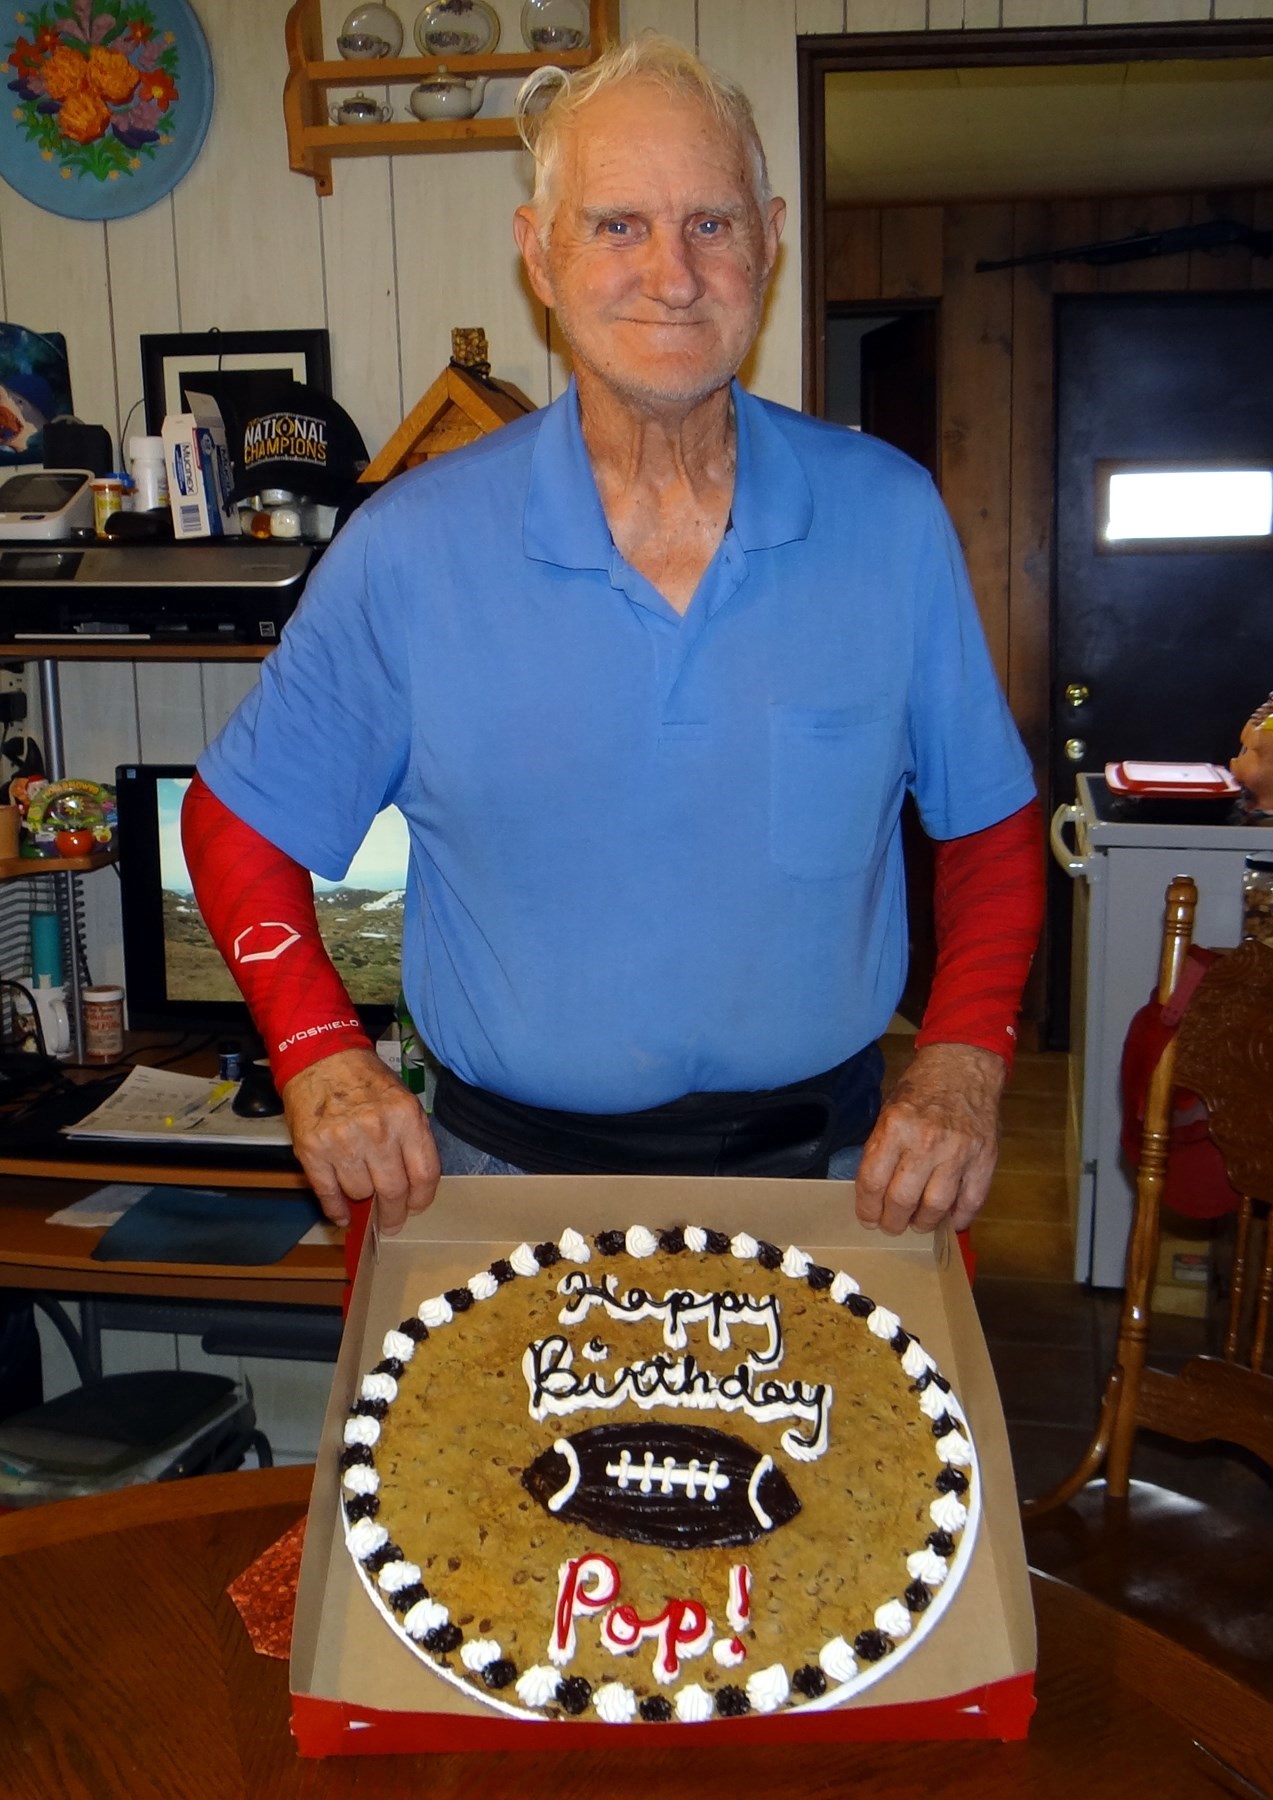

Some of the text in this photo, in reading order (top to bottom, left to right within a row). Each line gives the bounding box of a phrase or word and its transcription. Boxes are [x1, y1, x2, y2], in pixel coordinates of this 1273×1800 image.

[244, 415, 327, 446] NATIONAL
[244, 436, 327, 464] CHAMPIONS
[558, 1270, 783, 1370] Happy
[522, 1335, 831, 1460] Birthday
[548, 1552, 752, 1684] Pop!
